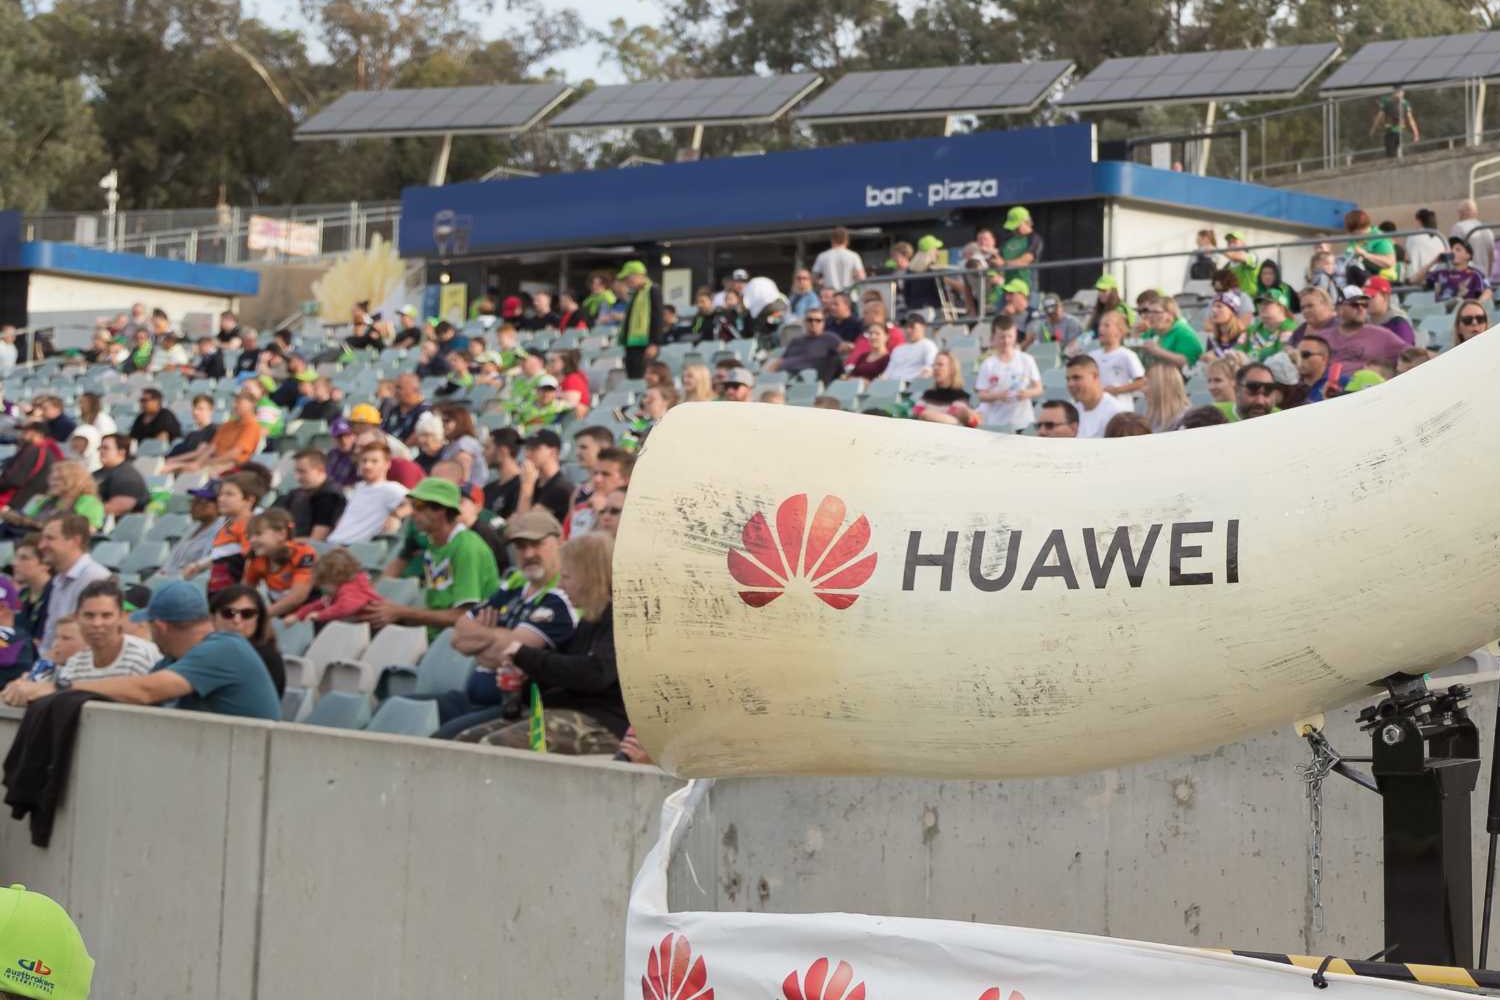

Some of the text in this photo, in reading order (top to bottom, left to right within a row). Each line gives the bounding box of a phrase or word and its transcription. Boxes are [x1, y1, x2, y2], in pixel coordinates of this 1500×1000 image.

[866, 178, 998, 207] bar pizza
[902, 519, 1240, 592] HUAWEI
